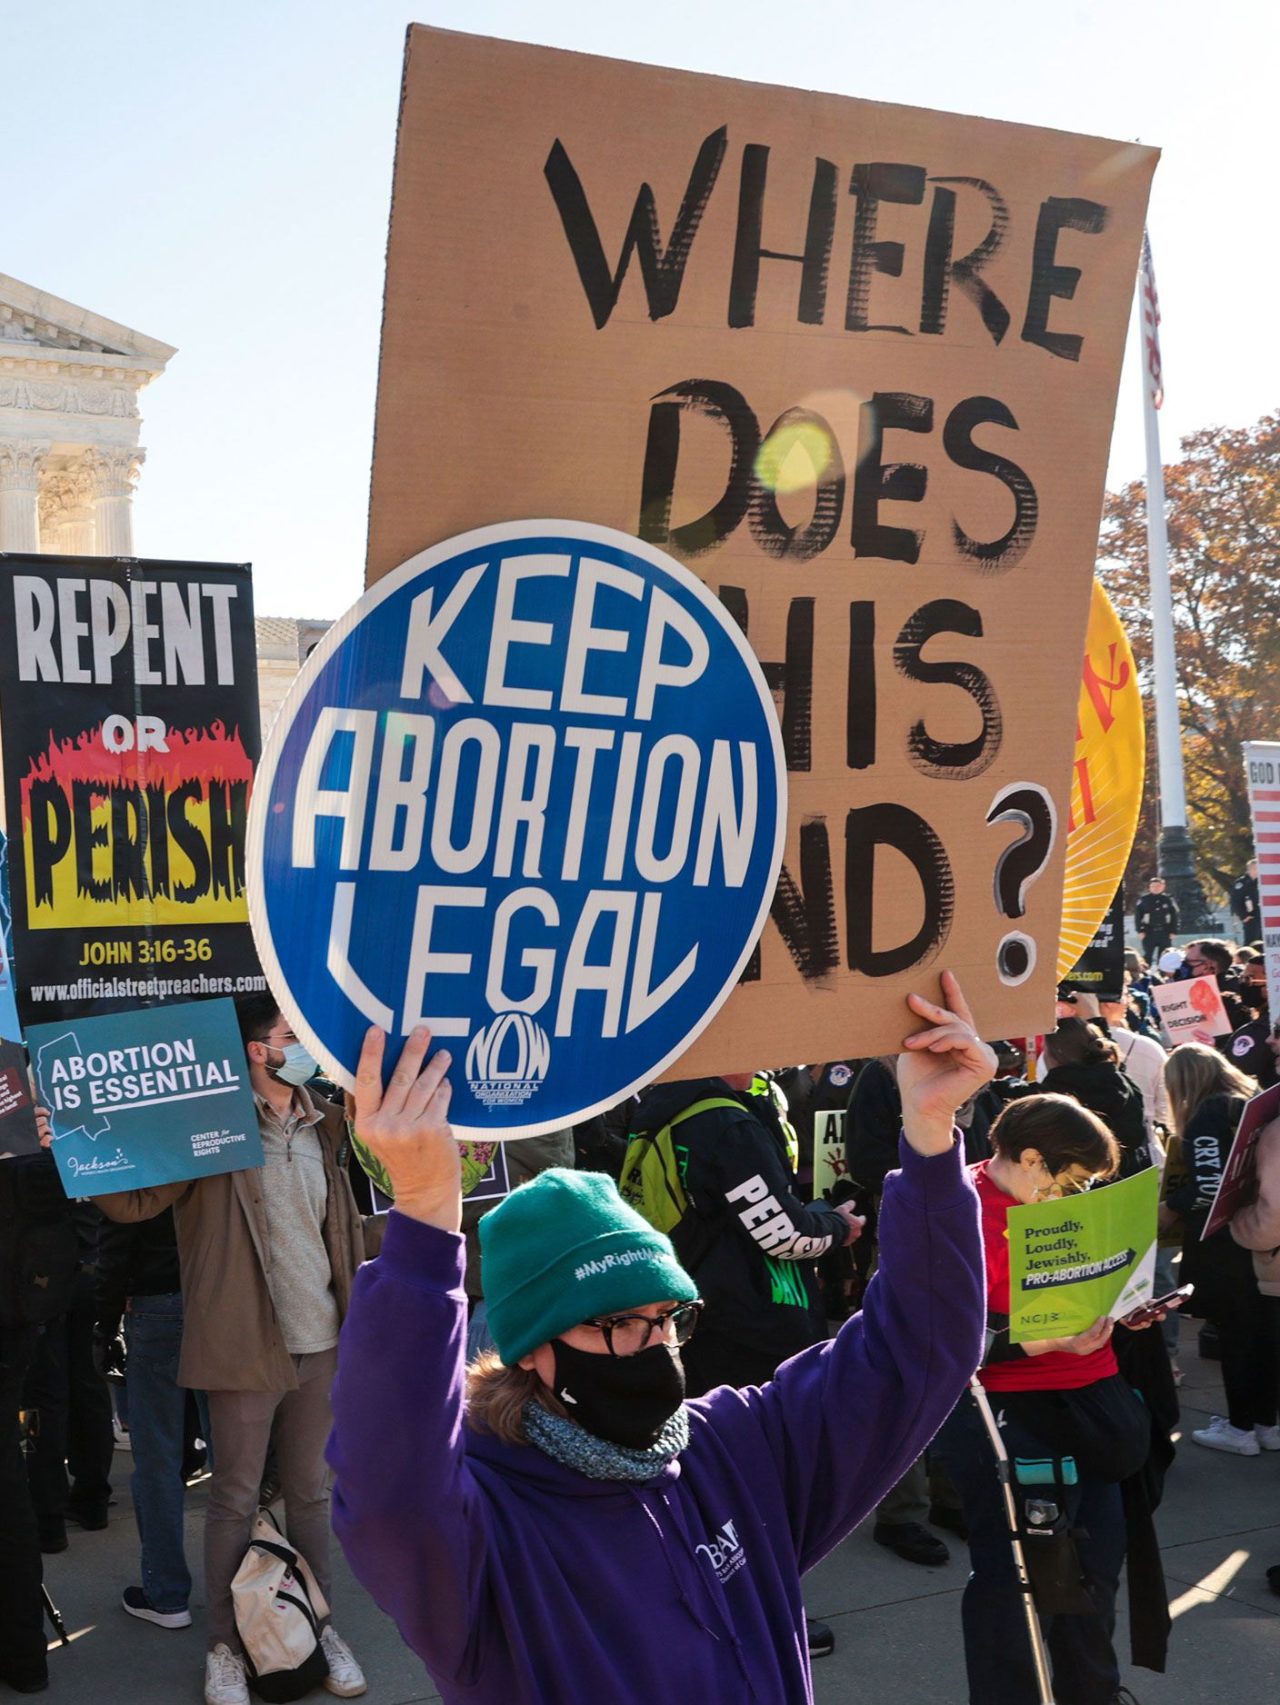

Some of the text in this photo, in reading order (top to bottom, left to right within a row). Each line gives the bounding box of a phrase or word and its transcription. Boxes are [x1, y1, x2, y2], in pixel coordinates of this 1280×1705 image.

[543, 124, 1113, 361] WHERE
[637, 379, 1040, 574] DOES
[13, 575, 238, 686] REPENT
[400, 553, 710, 721] KEEP
[720, 585, 1003, 781] HIS
[102, 713, 170, 753] OR
[1250, 761, 1274, 785] GOD
[292, 707, 758, 888] ABORTION
[25, 778, 250, 911] PERISH
[79, 938, 212, 967] JOHN 3:16-36
[326, 881, 700, 1039] LEGAL
[31, 973, 267, 1003] www.officialstreetpreachers.com
[51, 1038, 197, 1084] ABORTION
[54, 1059, 240, 1111] IS ESSENTIAL
[470, 1082, 539, 1090] NATIONAL
[190, 1130, 219, 1142] CENTER
[192, 1133, 247, 1149] REPRODUCTIVE
[193, 1146, 220, 1157] RIGHTS
[1193, 1136, 1221, 1168] CRY
[1025, 1262, 1102, 1286] PRO-ABORTION
